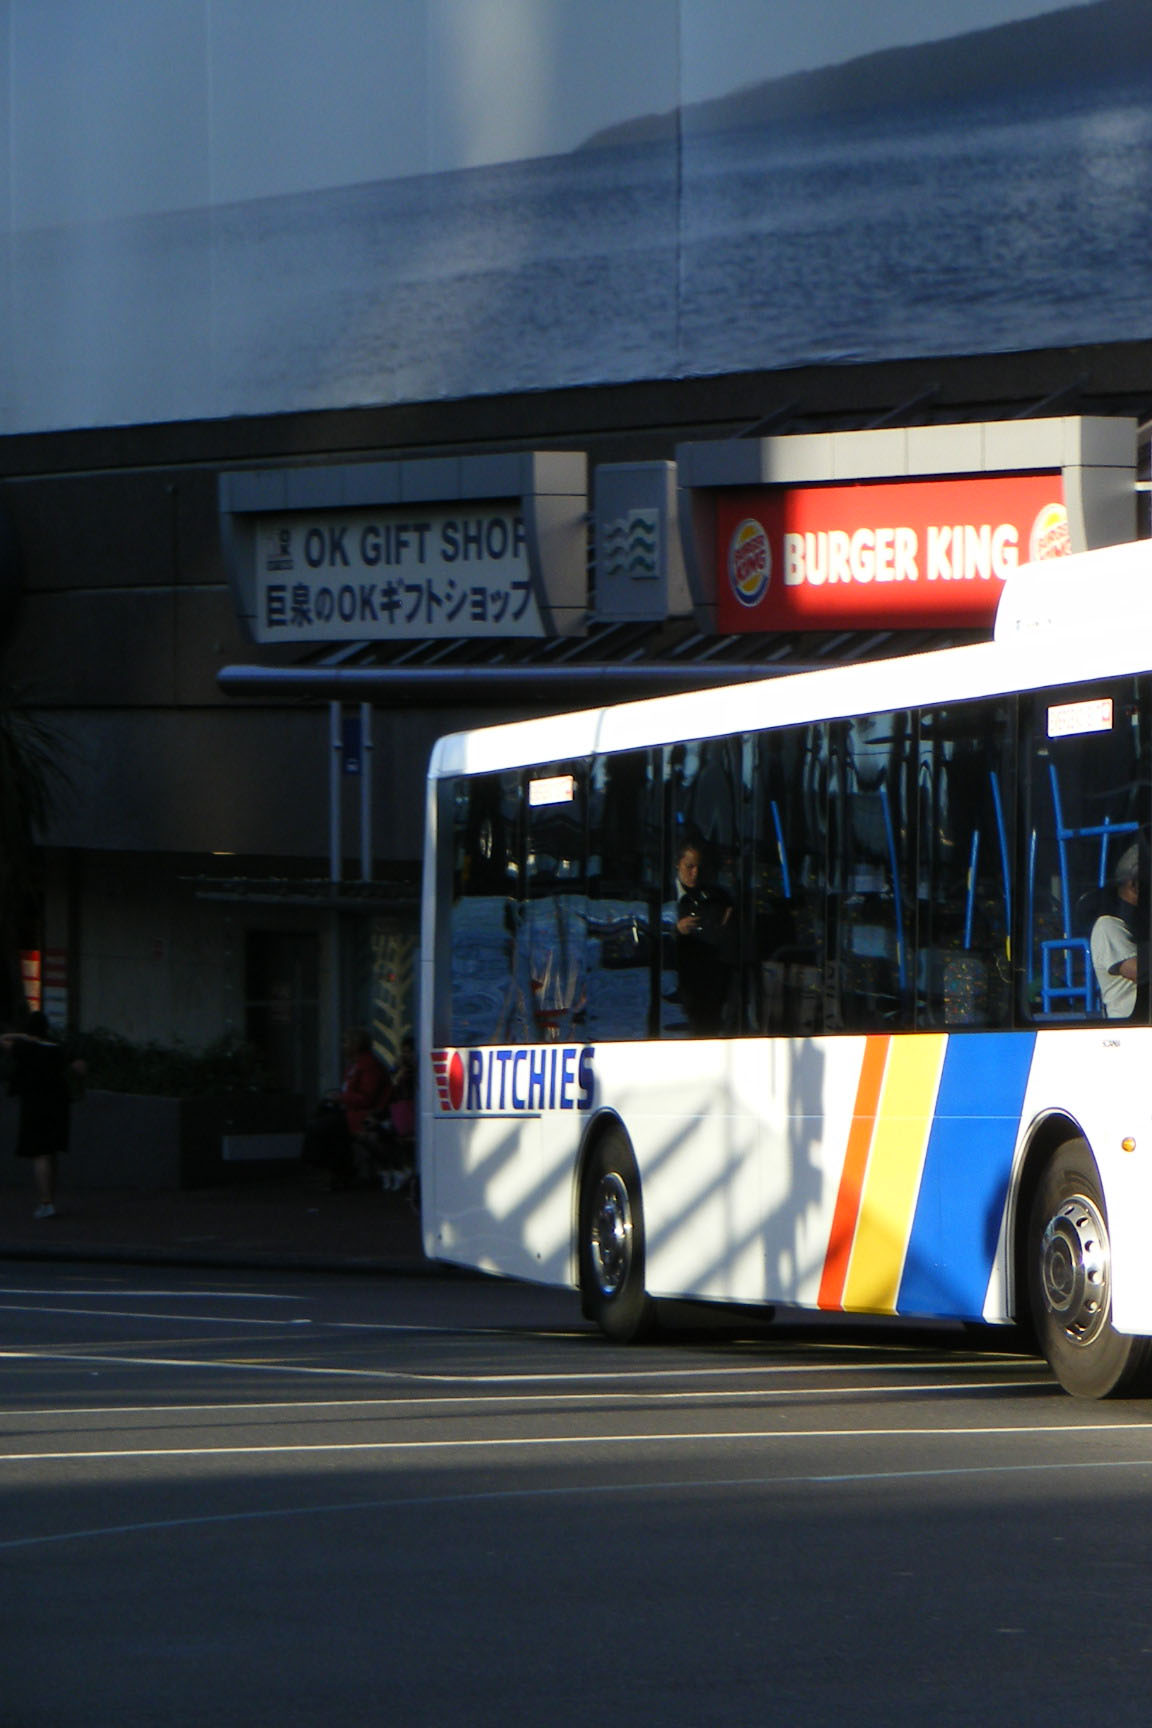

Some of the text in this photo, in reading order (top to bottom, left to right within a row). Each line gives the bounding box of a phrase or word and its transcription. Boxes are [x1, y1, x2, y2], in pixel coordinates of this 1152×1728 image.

[304, 526, 350, 567] OK
[361, 522, 431, 566] GIFT
[783, 527, 919, 586] BURGER
[927, 523, 1019, 581] KING
[467, 1047, 595, 1110] RITCHIES
